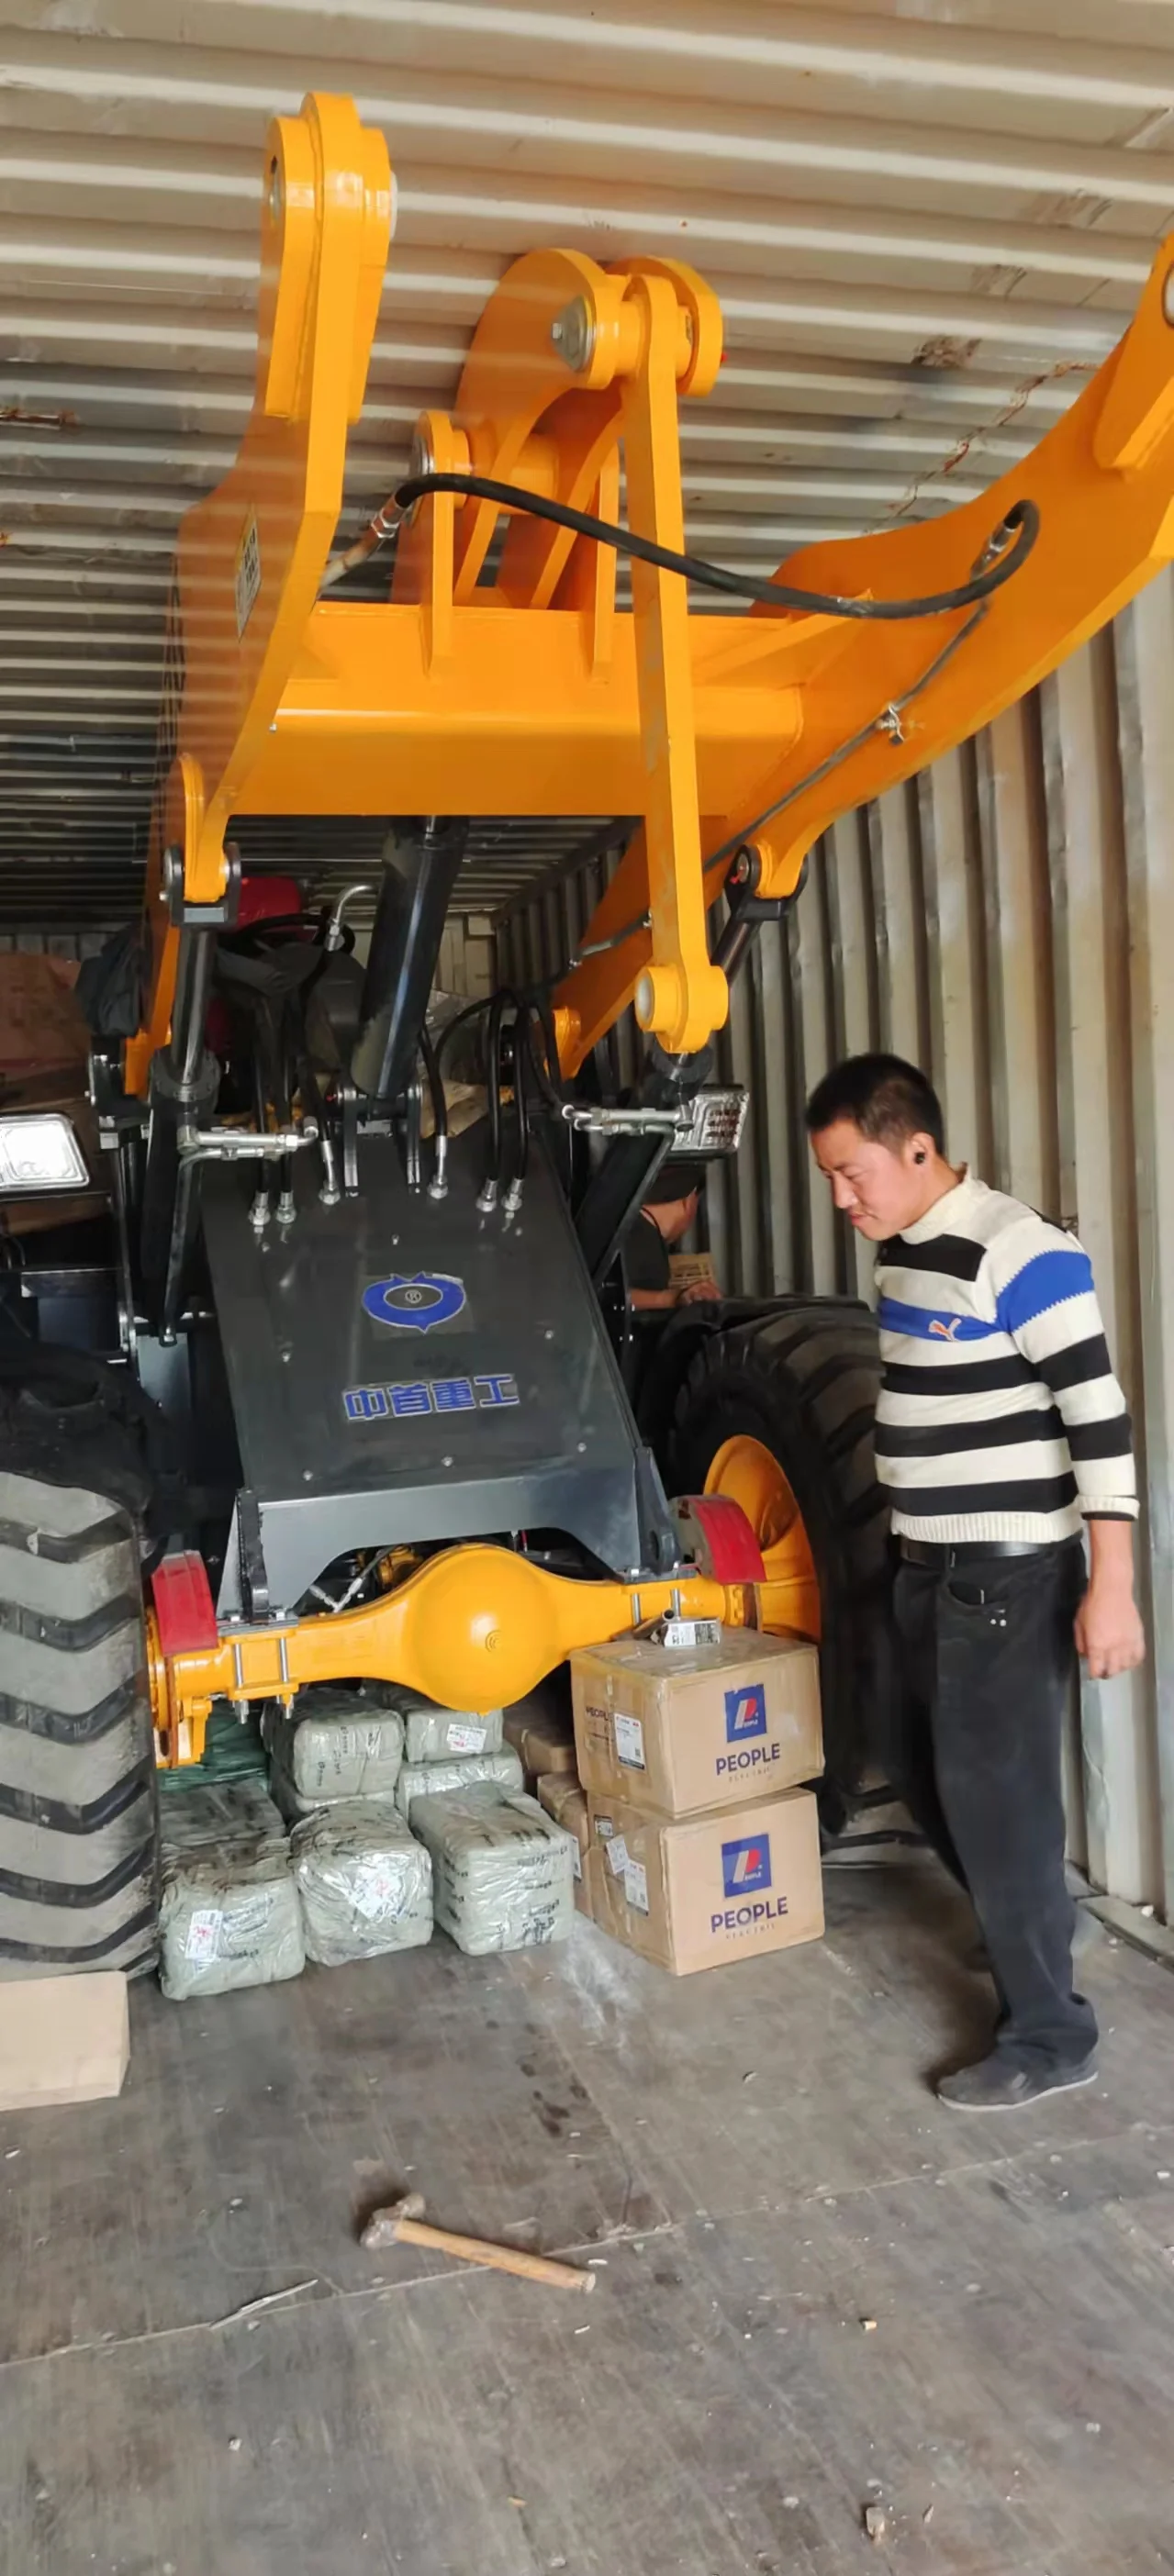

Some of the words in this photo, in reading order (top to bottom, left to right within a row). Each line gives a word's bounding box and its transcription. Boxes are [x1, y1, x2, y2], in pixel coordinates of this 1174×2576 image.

[343, 1374, 520, 1420] 中首重工
[716, 1743, 780, 1776] PEOPLE
[710, 1896, 788, 1933] PEOPLE
